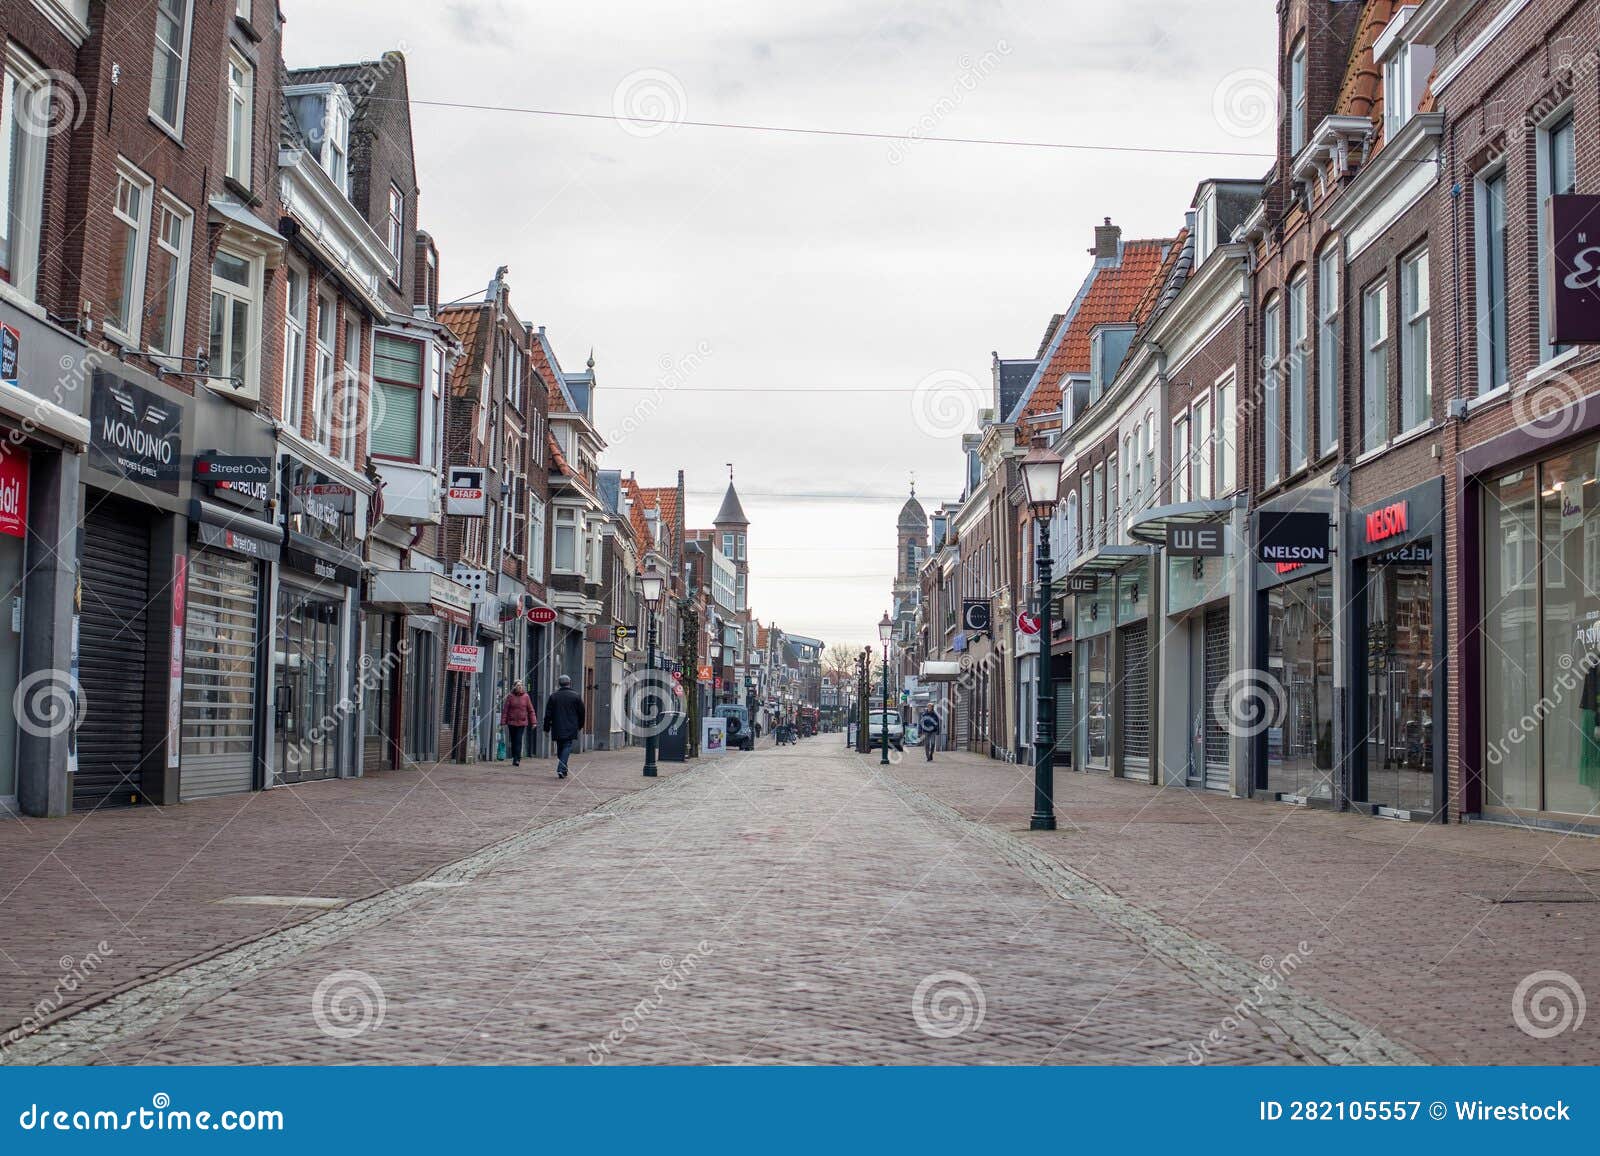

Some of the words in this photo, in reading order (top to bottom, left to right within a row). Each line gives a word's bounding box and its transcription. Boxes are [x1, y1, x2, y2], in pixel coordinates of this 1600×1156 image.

[103, 416, 171, 464] MONDINIO
[118, 457, 137, 471] WATCHES
[141, 465, 157, 477] JEWELS
[453, 490, 479, 498] PFAFF
[1366, 499, 1407, 543] NELSON
[1173, 529, 1217, 549] WE
[1264, 546, 1324, 560] NELSON
[1070, 579, 1095, 590] WE
[459, 646, 477, 655] KOOP
